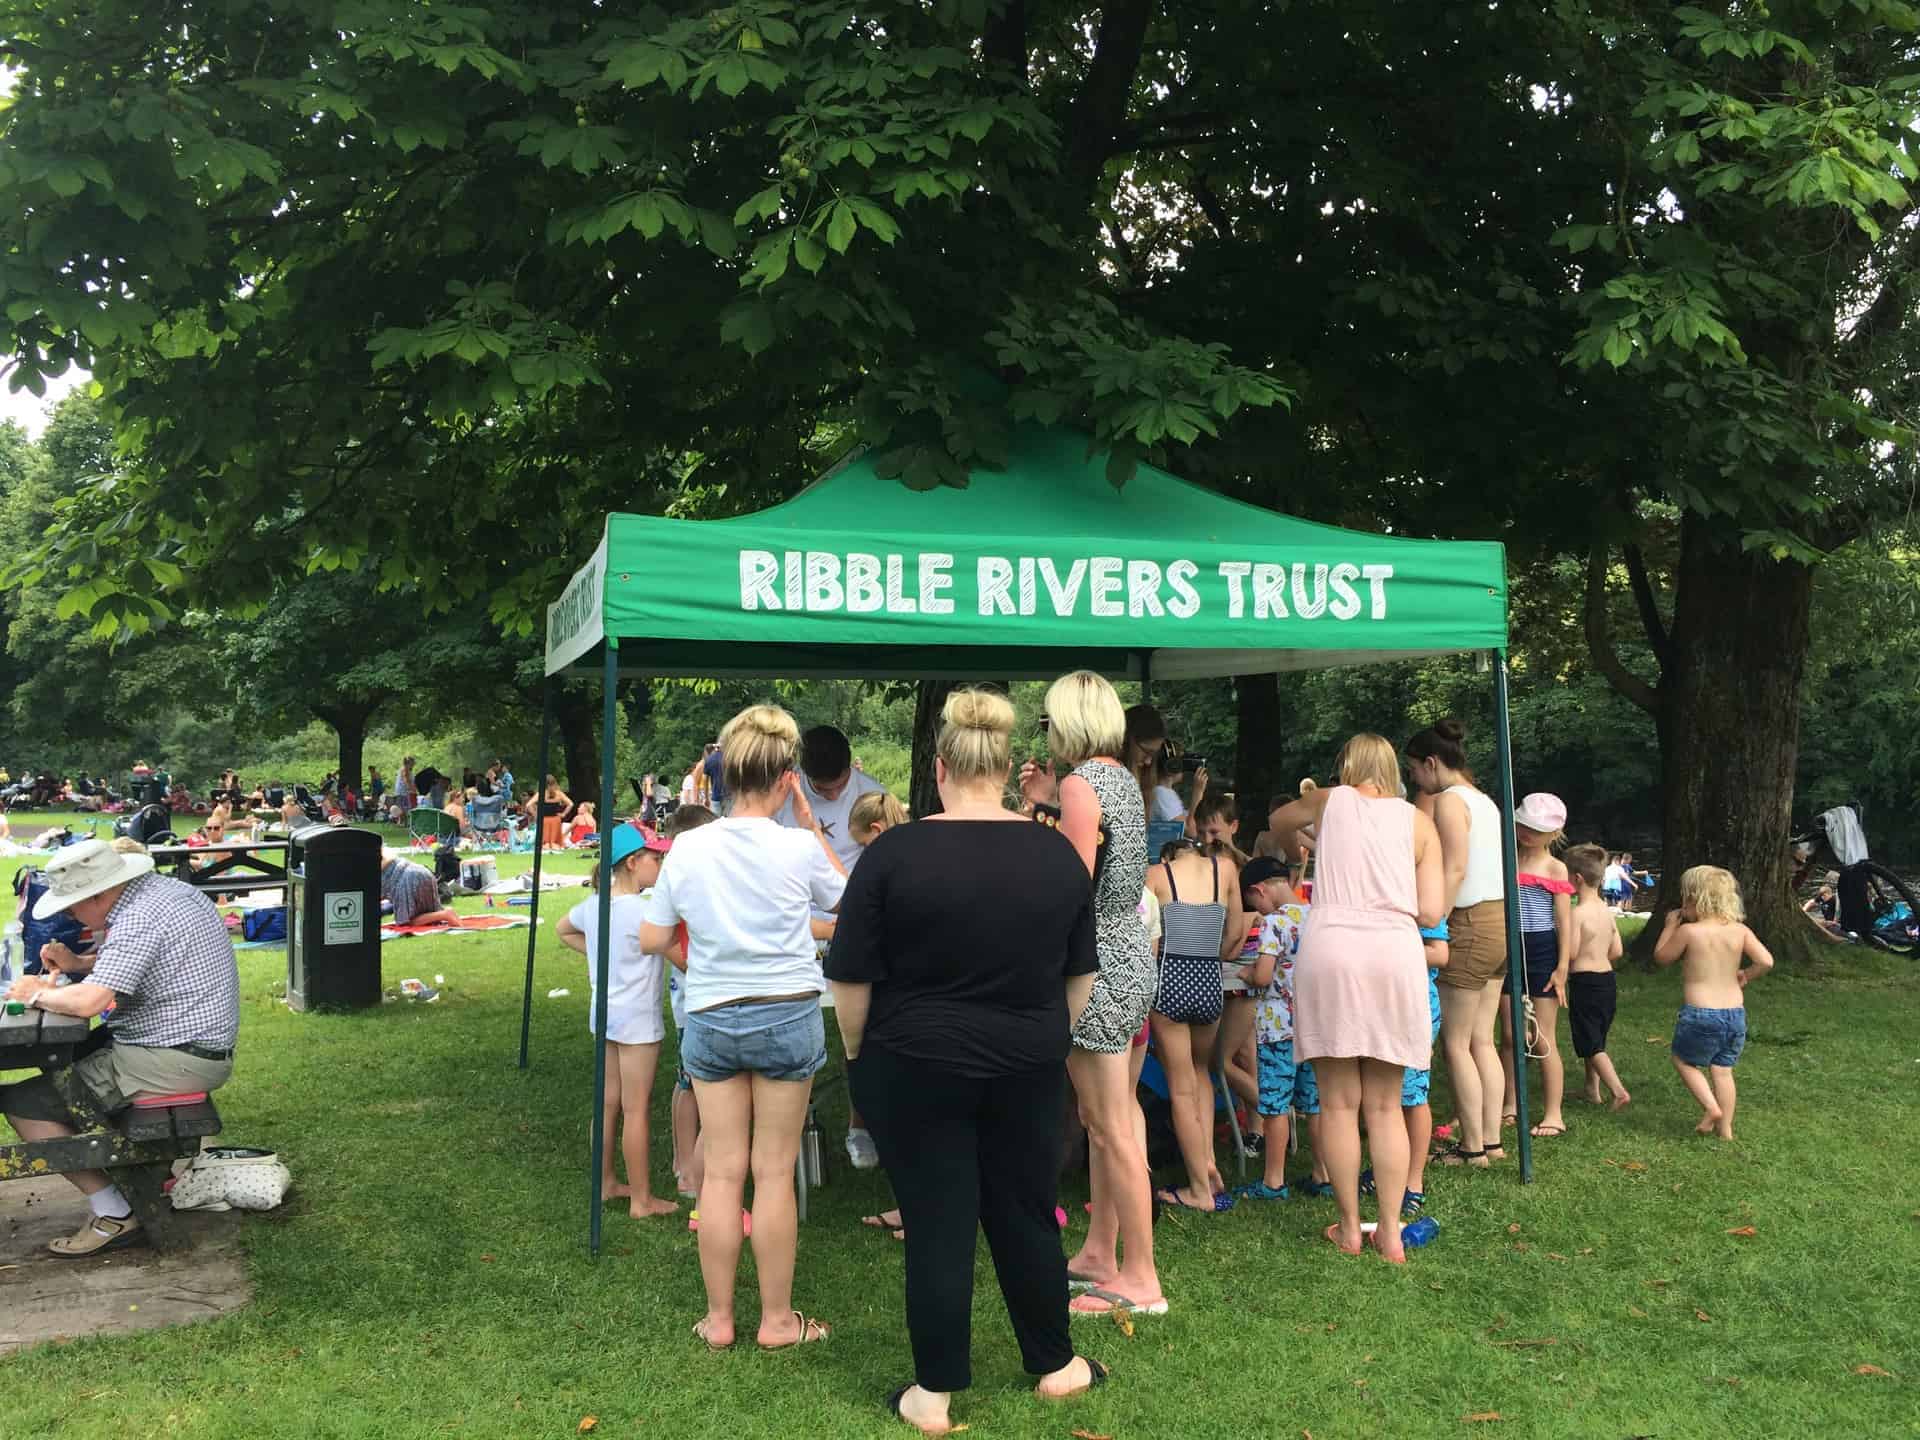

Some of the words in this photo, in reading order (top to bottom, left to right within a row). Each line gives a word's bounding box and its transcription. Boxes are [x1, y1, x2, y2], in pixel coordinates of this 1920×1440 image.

[739, 550, 955, 613] RIBBLE
[977, 556, 1201, 618] RIVERS
[1218, 561, 1394, 620] TRUST
